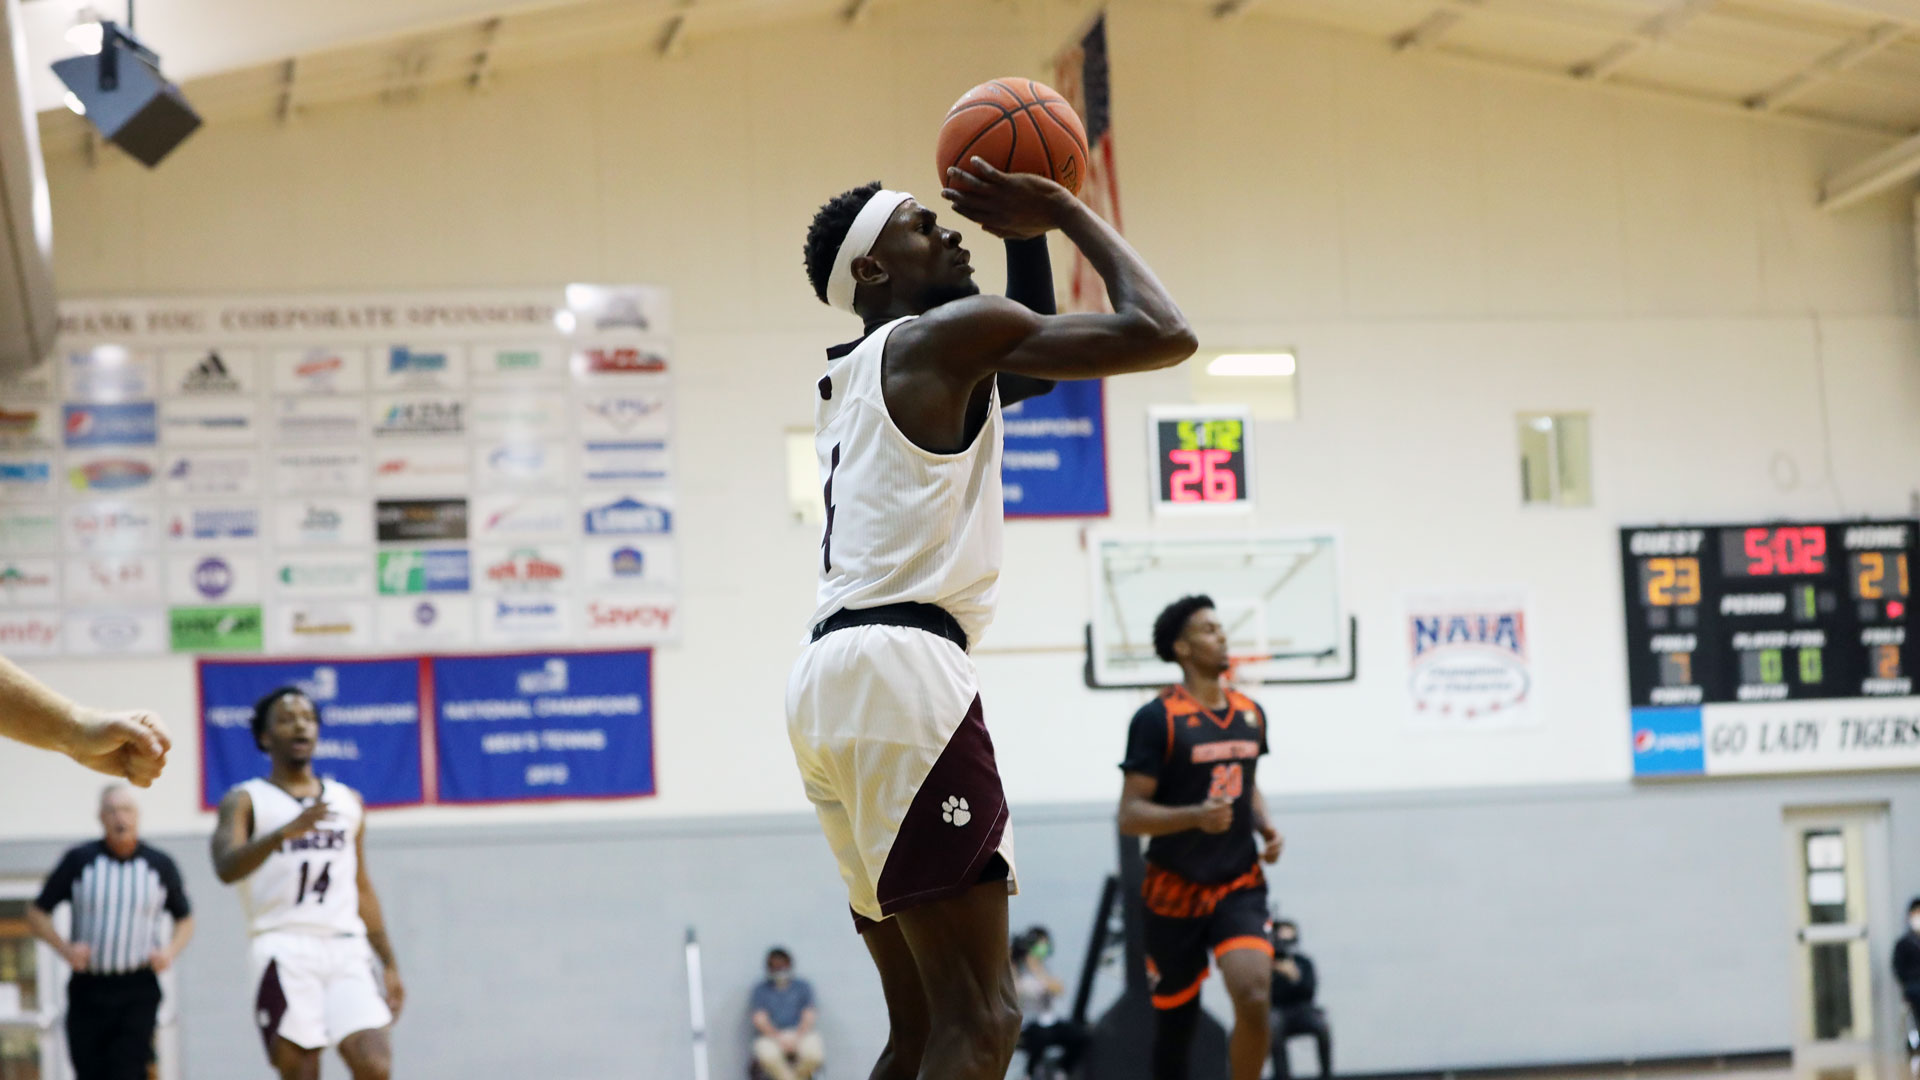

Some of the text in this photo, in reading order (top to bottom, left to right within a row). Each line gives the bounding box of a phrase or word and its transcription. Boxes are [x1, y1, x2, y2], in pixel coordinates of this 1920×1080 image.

[1169, 449, 1237, 504] 26
[1630, 530, 1704, 555] GUEST
[1844, 525, 1908, 548] HOME
[1648, 557, 1701, 606] 23
[1859, 552, 1909, 599] 21
[1720, 593, 1786, 615] PERIOD
[1804, 585, 1816, 618] 1
[1414, 613, 1519, 656] NAIA
[1760, 649, 1783, 684] 0
[1799, 647, 1822, 684] 0
[1878, 645, 1901, 679] 2
[321, 703, 418, 726] CHAMPIONS
[442, 694, 641, 721] NATIONAL CHAMPIONS
[540, 728, 607, 751] TENNIS
[1711, 713, 1920, 756] GO LADY TIGERS
[1208, 763, 1243, 798] 20
[296, 861, 331, 905] 14
